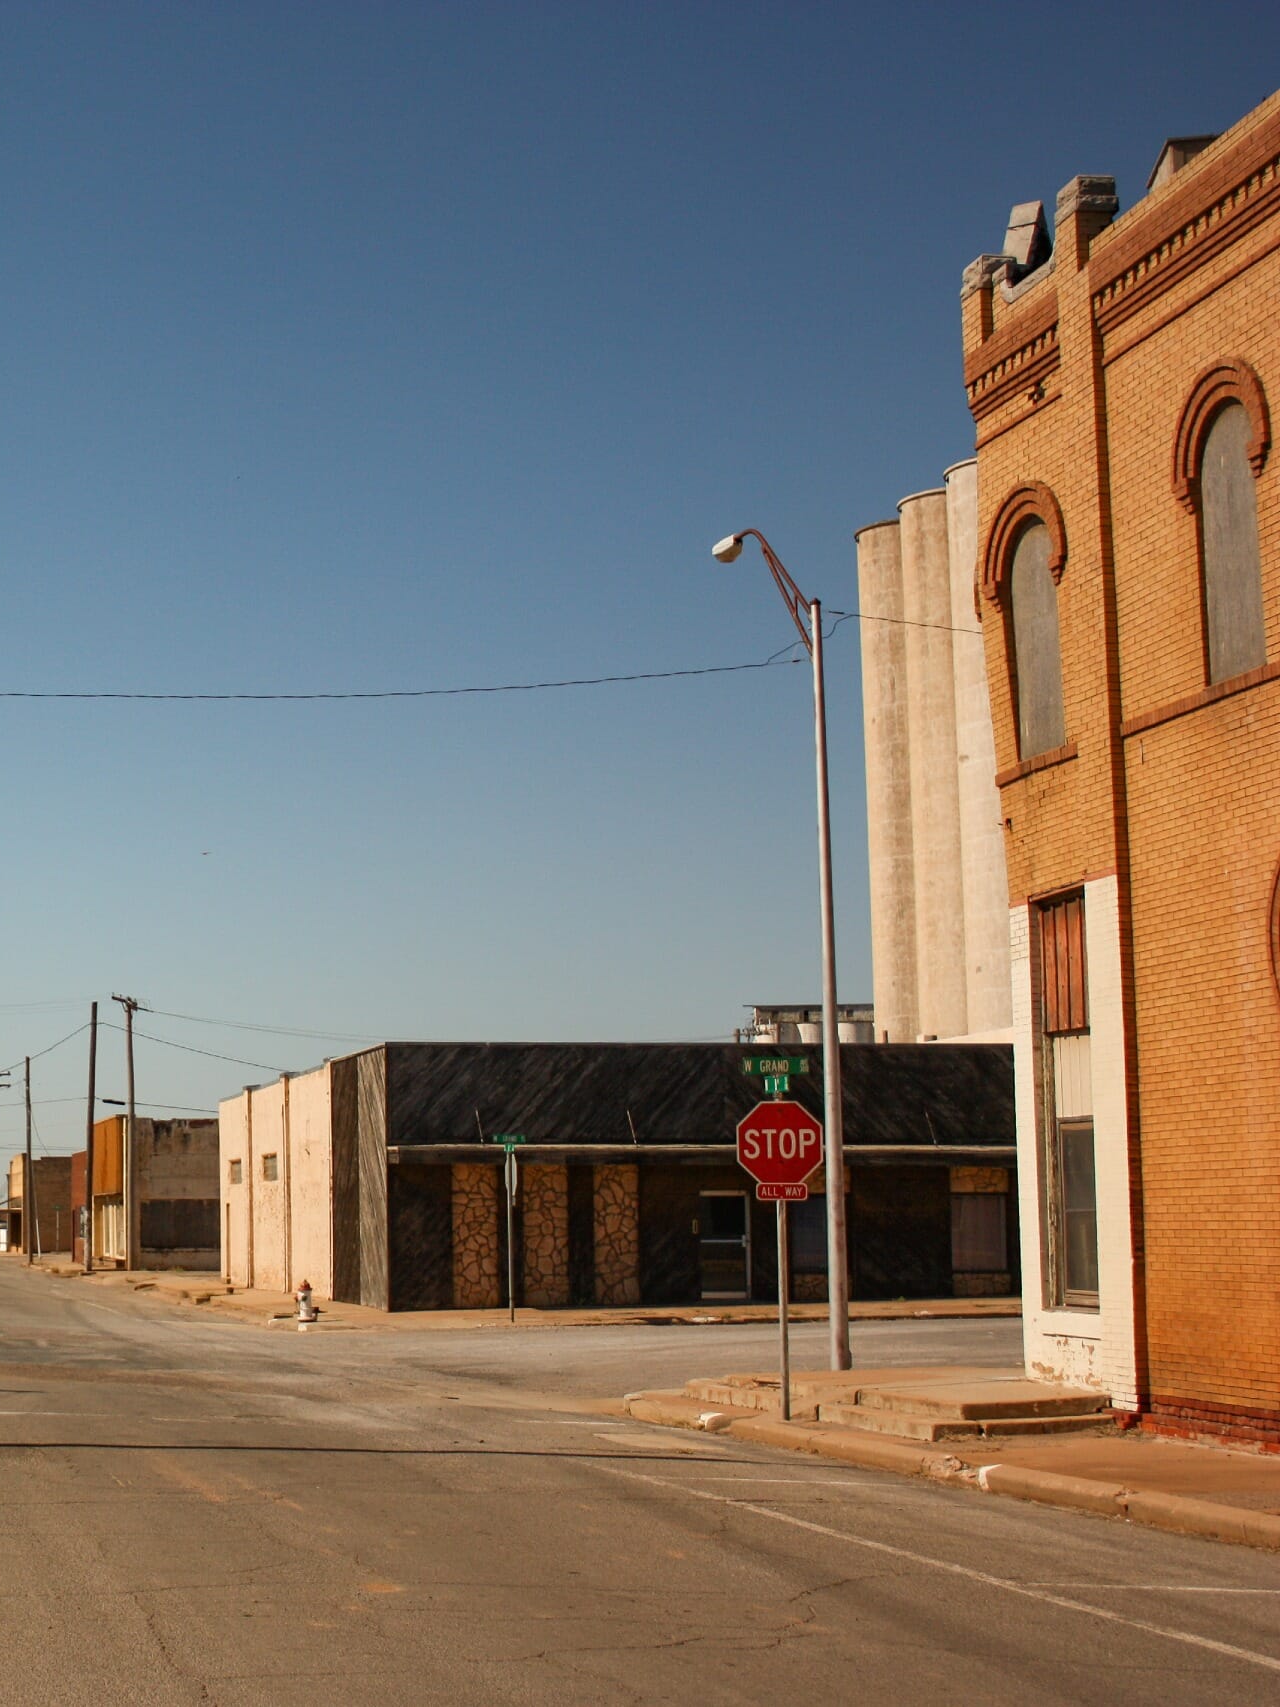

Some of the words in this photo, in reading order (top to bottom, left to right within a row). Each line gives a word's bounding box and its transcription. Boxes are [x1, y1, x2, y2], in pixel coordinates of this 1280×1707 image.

[744, 1060, 752, 1072] W
[759, 1060, 789, 1073] GRAND
[743, 1128, 816, 1159] STOP
[761, 1187, 779, 1197] ALL
[784, 1187, 803, 1197] WAY
